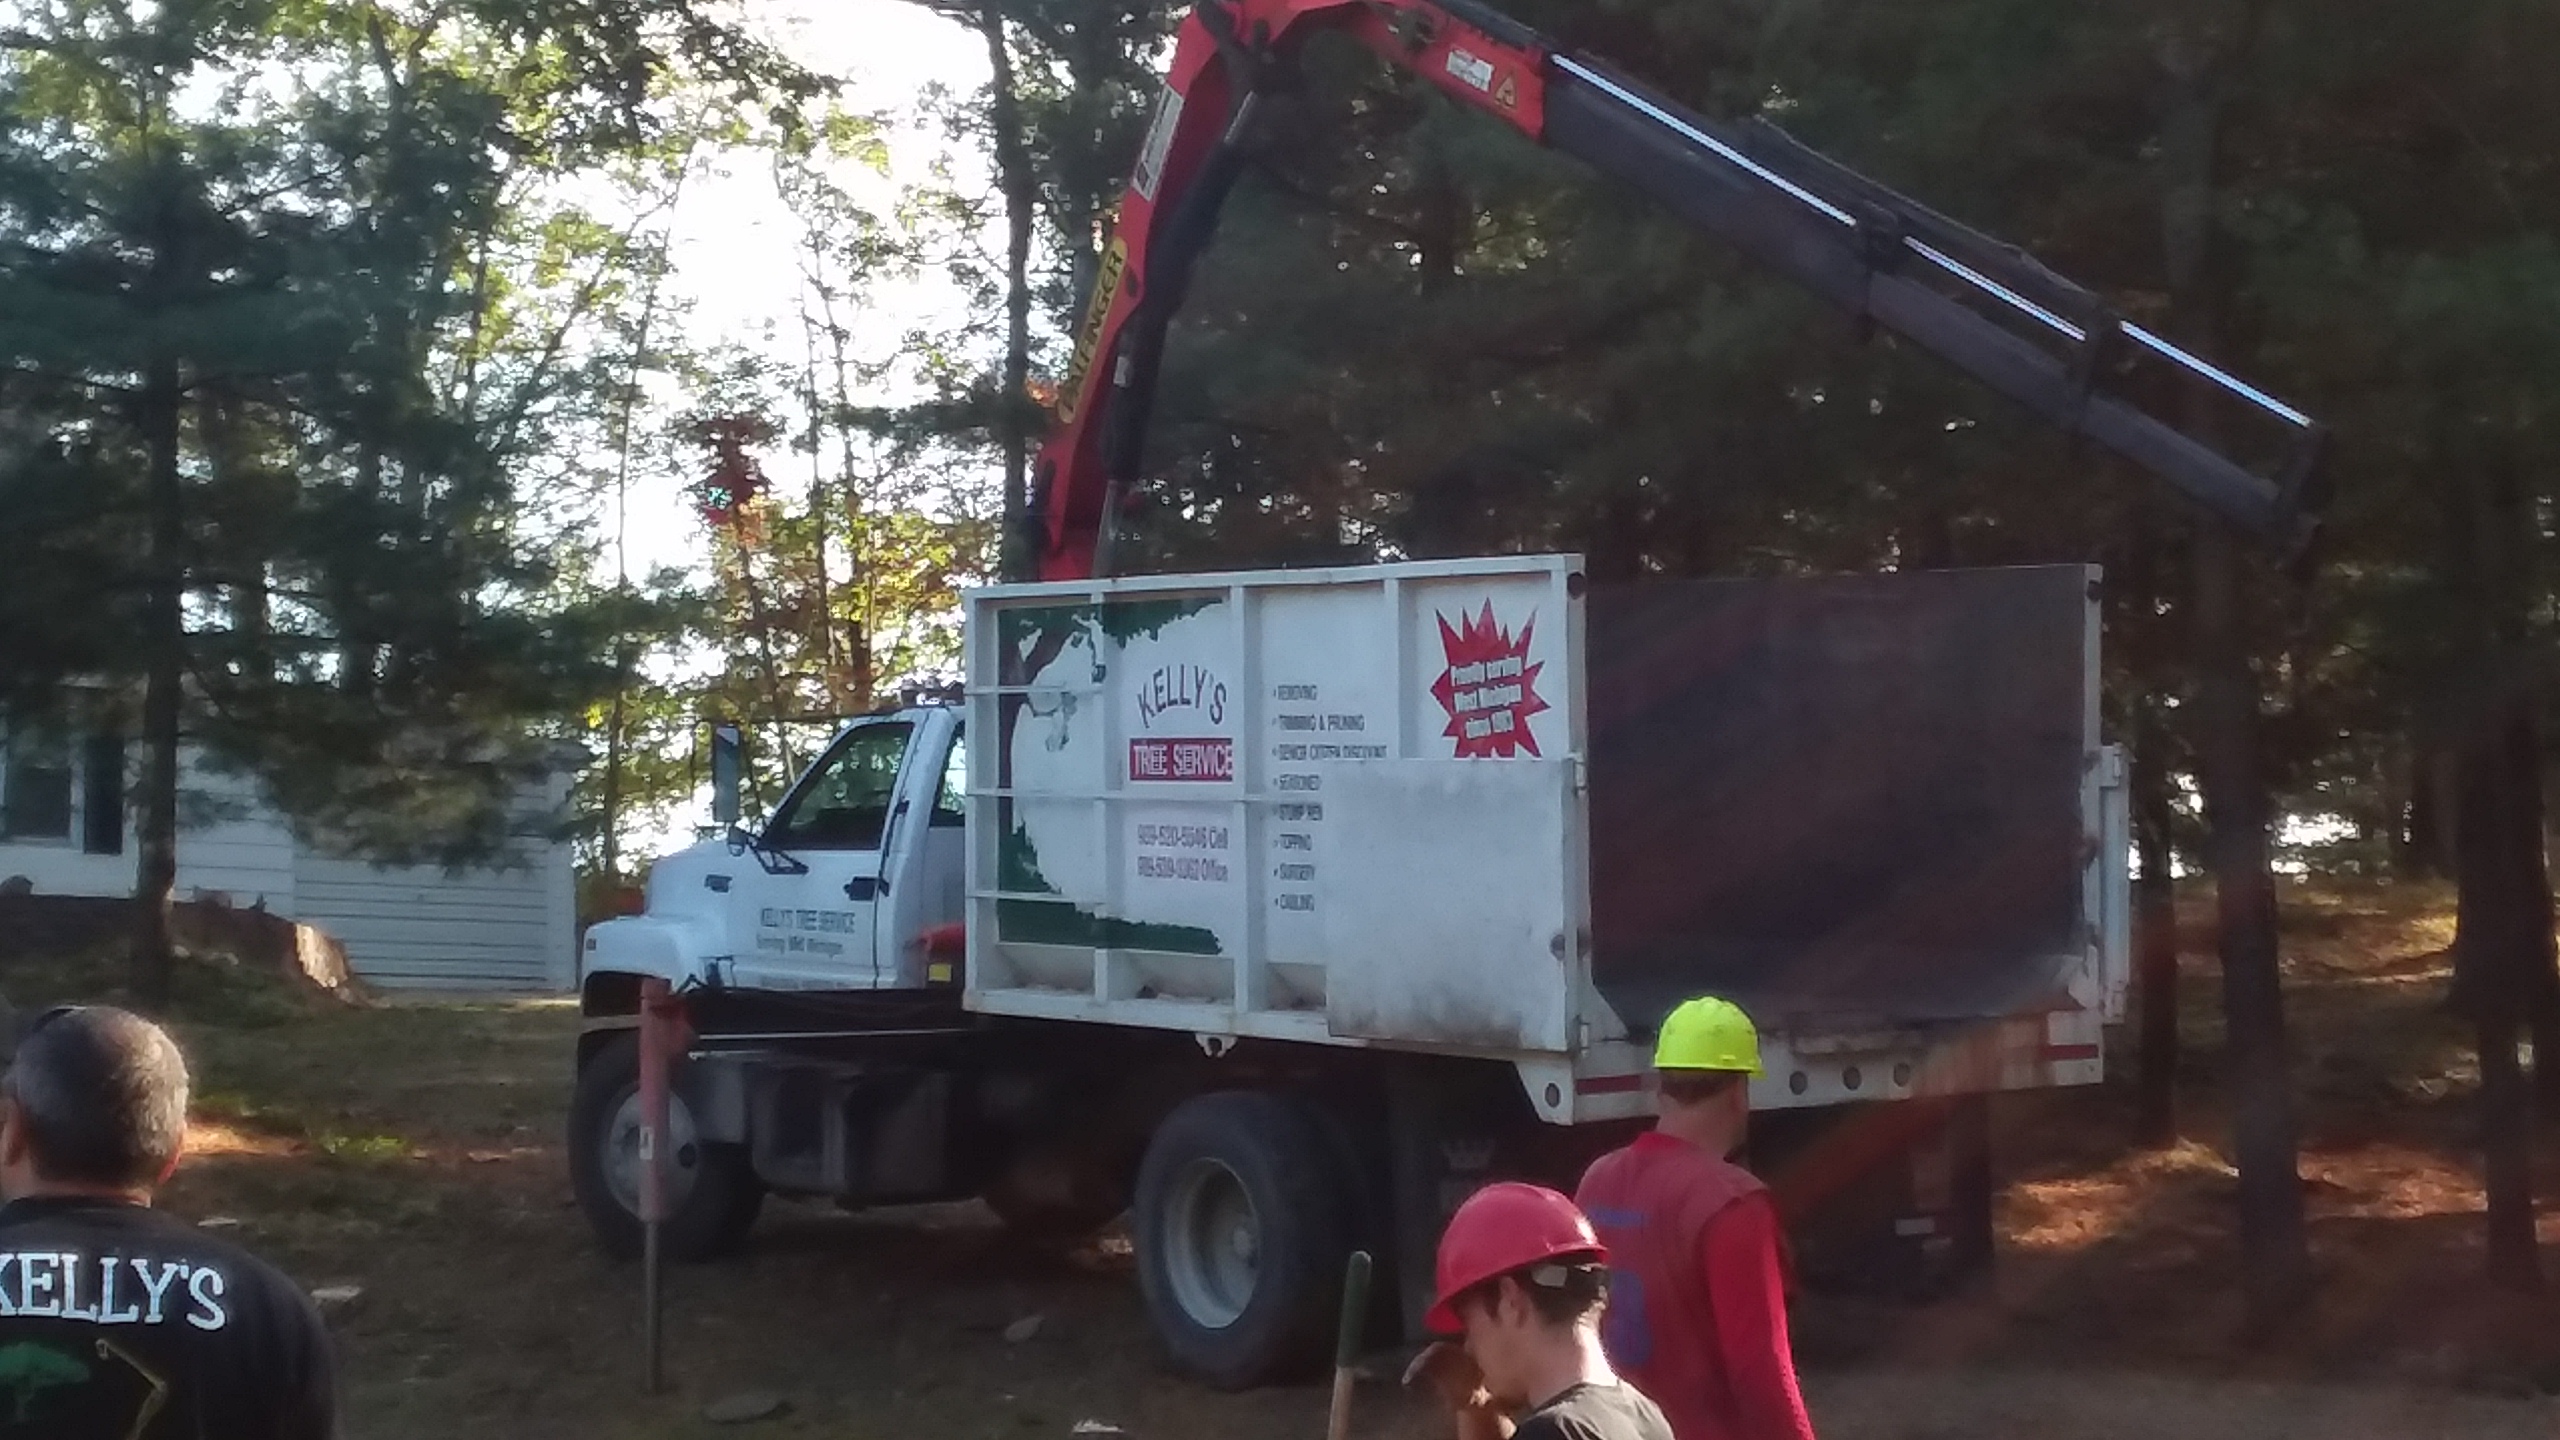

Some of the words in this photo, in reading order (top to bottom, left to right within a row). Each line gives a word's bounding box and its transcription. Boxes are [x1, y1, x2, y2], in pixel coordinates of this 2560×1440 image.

[1137, 663, 1227, 729] KELLY'S
[1327, 714, 1365, 731] PRUNING
[1133, 744, 1168, 776] TREE
[1173, 743, 1232, 777] SERVICE
